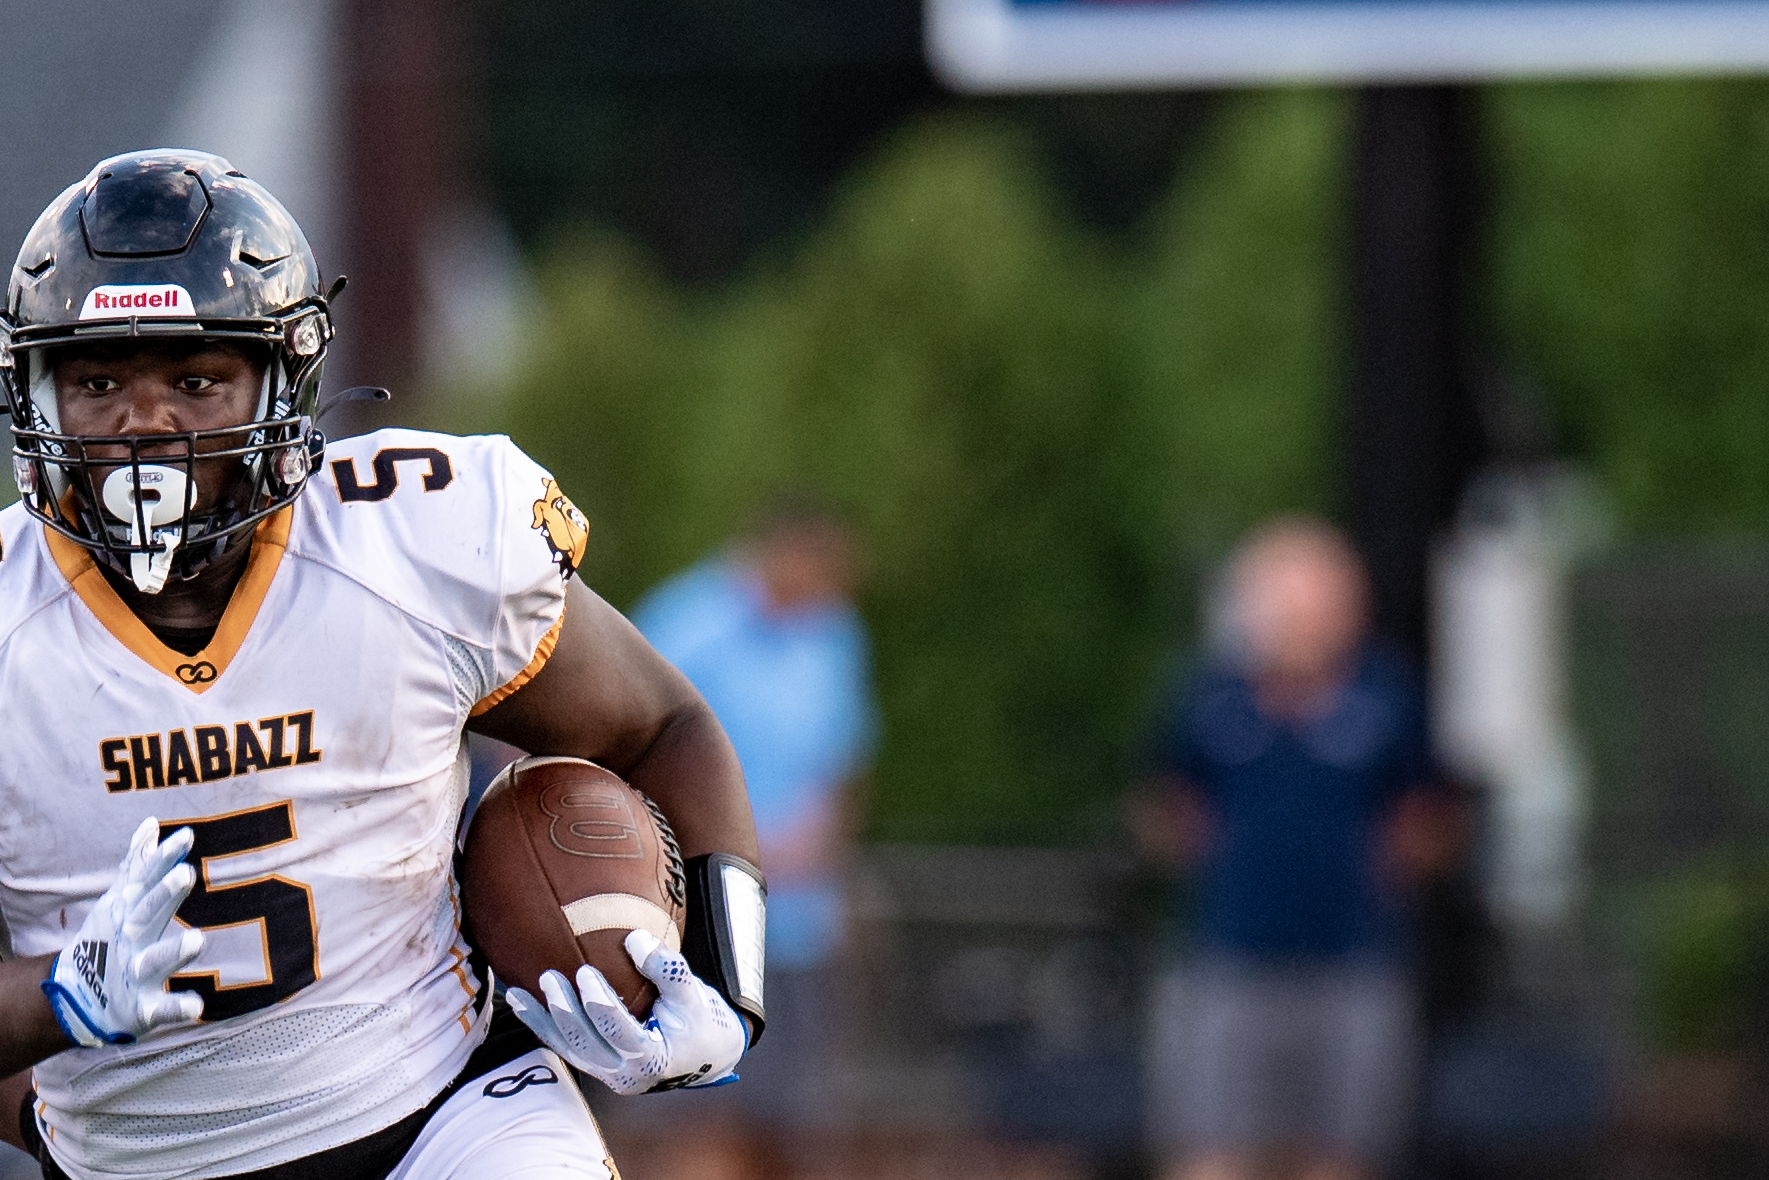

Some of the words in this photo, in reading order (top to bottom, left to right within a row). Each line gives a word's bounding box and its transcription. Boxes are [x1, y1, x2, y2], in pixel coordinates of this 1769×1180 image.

[94, 289, 179, 311] Riddell
[329, 447, 453, 503] 5
[98, 709, 323, 794] SHABAZZ
[157, 799, 320, 1023] 5
